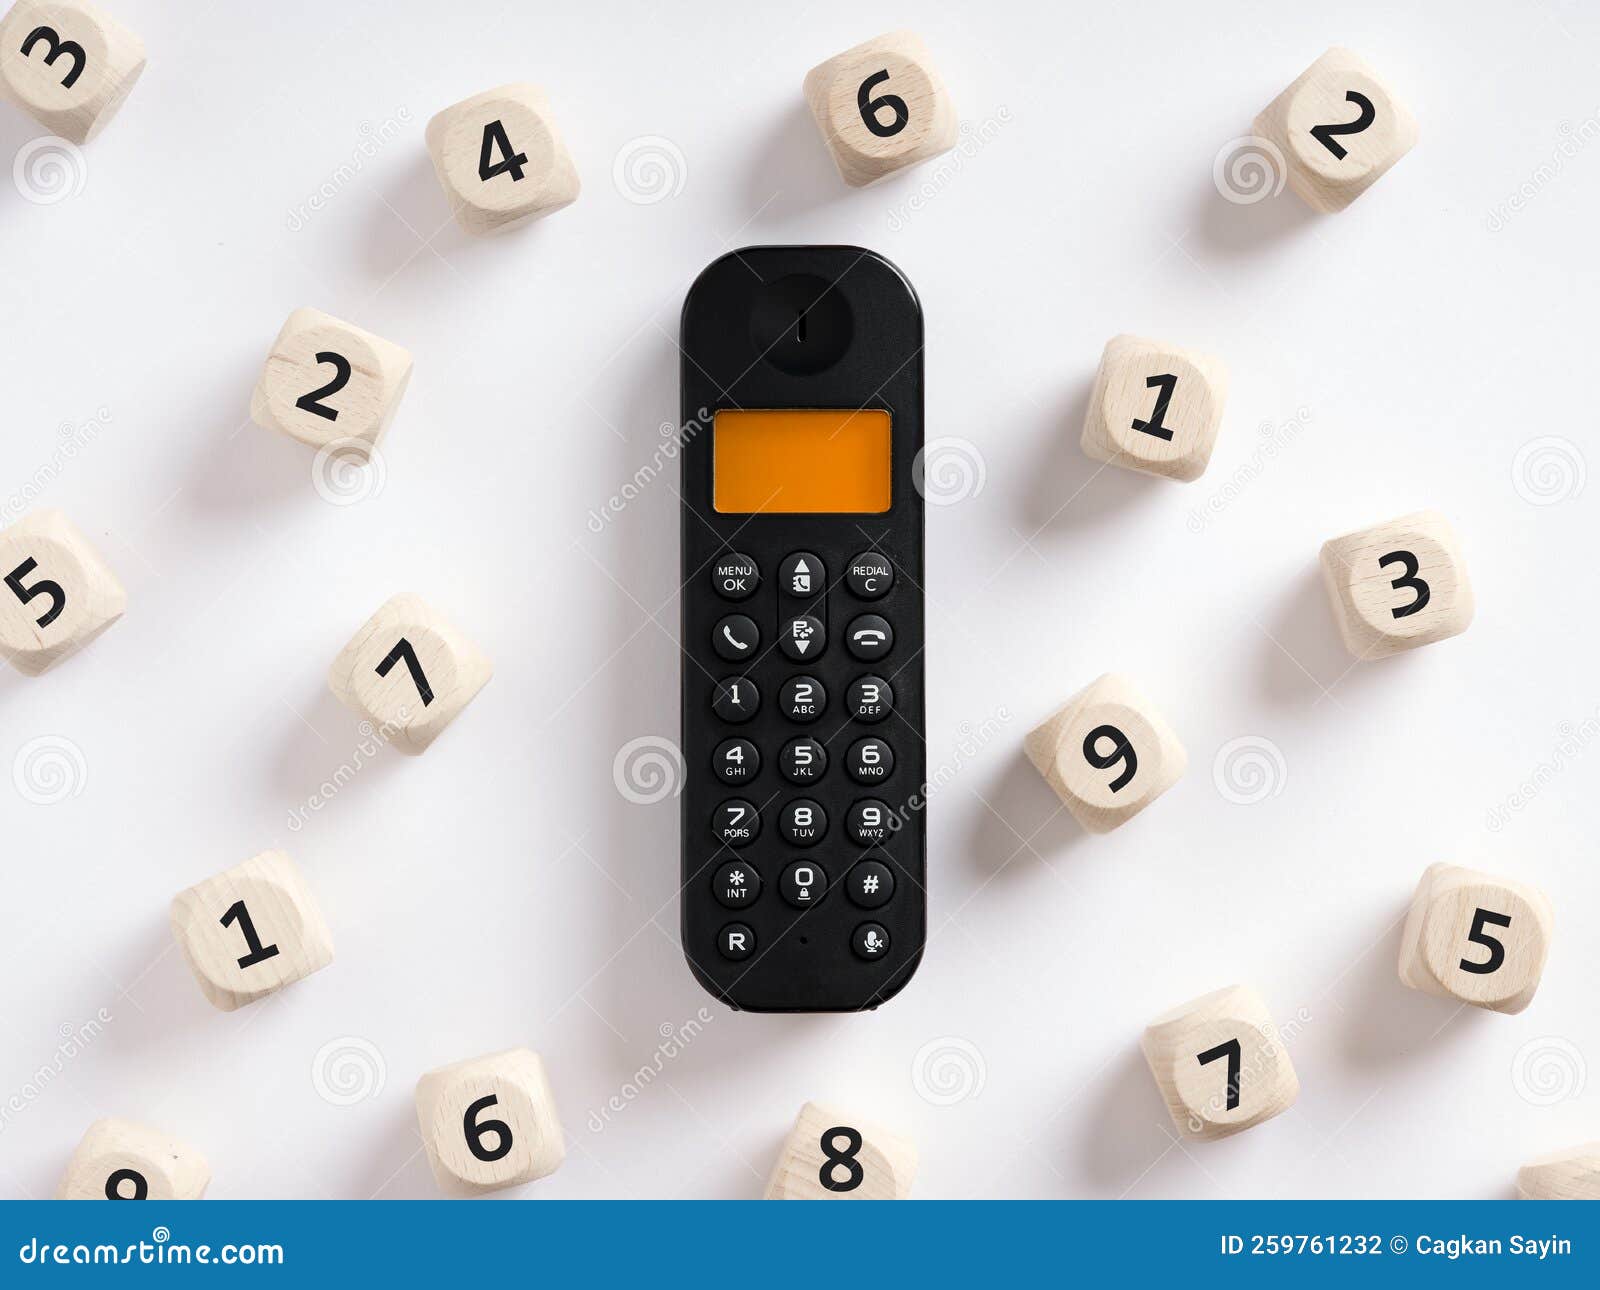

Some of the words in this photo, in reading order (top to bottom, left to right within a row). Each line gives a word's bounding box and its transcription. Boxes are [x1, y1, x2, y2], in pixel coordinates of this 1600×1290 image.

[20, 26, 86, 88] 3
[857, 69, 909, 137] 6
[1310, 91, 1375, 160] 2
[478, 120, 528, 182] 4
[295, 351, 352, 422] 2
[1131, 373, 1178, 442] 1
[718, 565, 753, 576] MENU
[853, 566, 889, 576] REDIAL
[4, 557, 66, 629] 5
[723, 578, 747, 591] OK
[864, 578, 877, 592] C
[1378, 551, 1431, 619] 3
[375, 637, 434, 708] 7
[730, 684, 741, 704] 1
[794, 683, 813, 703] 2
[861, 684, 880, 704] 3
[792, 705, 816, 714] ABC
[859, 705, 881, 715] DEF
[725, 746, 744, 765] 4
[794, 745, 813, 765] 5
[861, 744, 881, 764] 6
[1083, 724, 1138, 793] 9
[725, 767, 746, 776] GHI
[793, 767, 814, 776] JKL
[858, 766, 884, 776] MNO
[727, 807, 745, 826] 7
[794, 807, 813, 826] 8
[862, 807, 881, 826] 9
[792, 828, 815, 838] TUV
[858, 828, 884, 838] WXYZ
[727, 888, 748, 898] INT
[863, 874, 879, 894] #
[219, 900, 279, 969] 1
[728, 932, 746, 951] R
[1459, 907, 1512, 975] 5
[1196, 1038, 1241, 1111] 7
[463, 1094, 513, 1162] 6
[818, 1126, 864, 1193] 8
